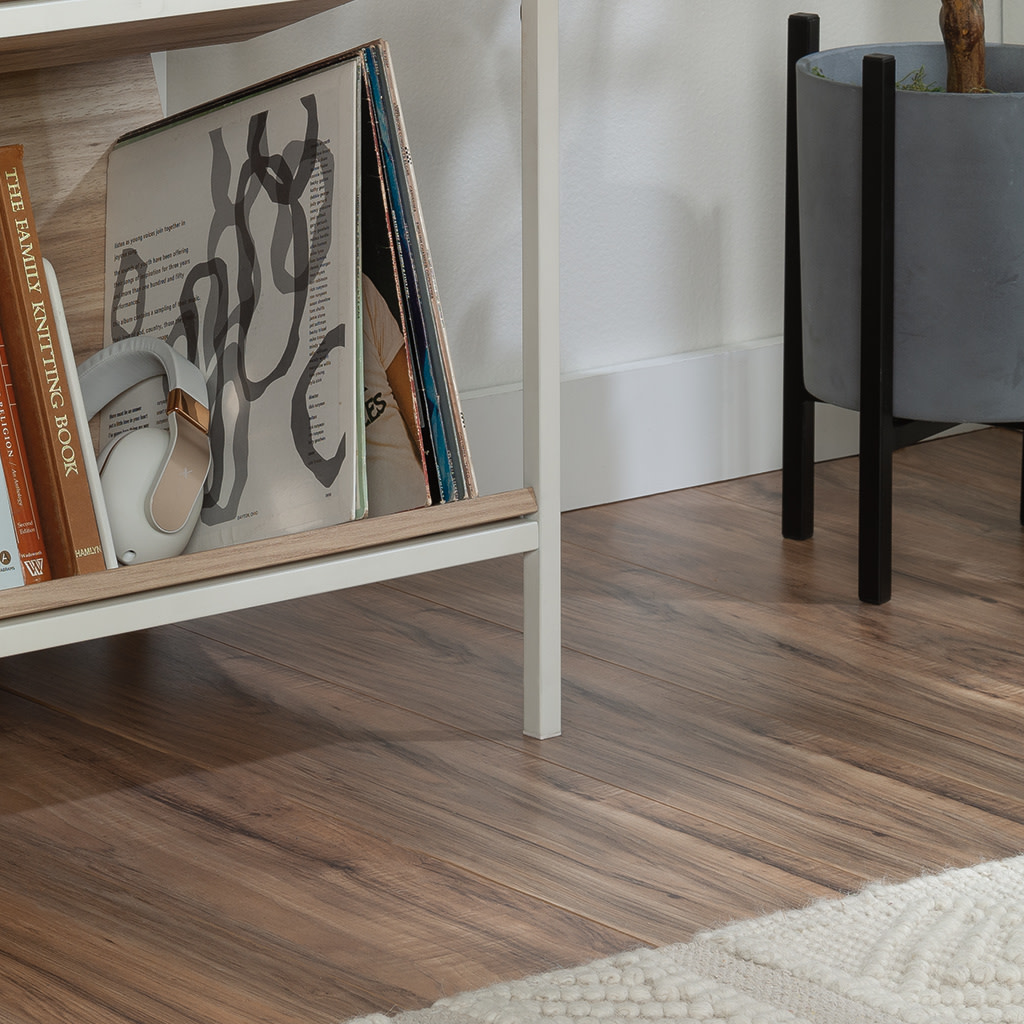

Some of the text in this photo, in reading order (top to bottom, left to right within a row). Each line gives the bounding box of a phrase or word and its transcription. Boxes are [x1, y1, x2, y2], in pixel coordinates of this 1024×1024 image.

[164, 221, 180, 232] together
[5, 167, 79, 477] THE FAMILY KNITTING BOOK
[364, 392, 387, 427] ES
[17, 520, 33, 528] Second
[19, 527, 36, 535] Edition
[74, 545, 102, 558] HAMLYN
